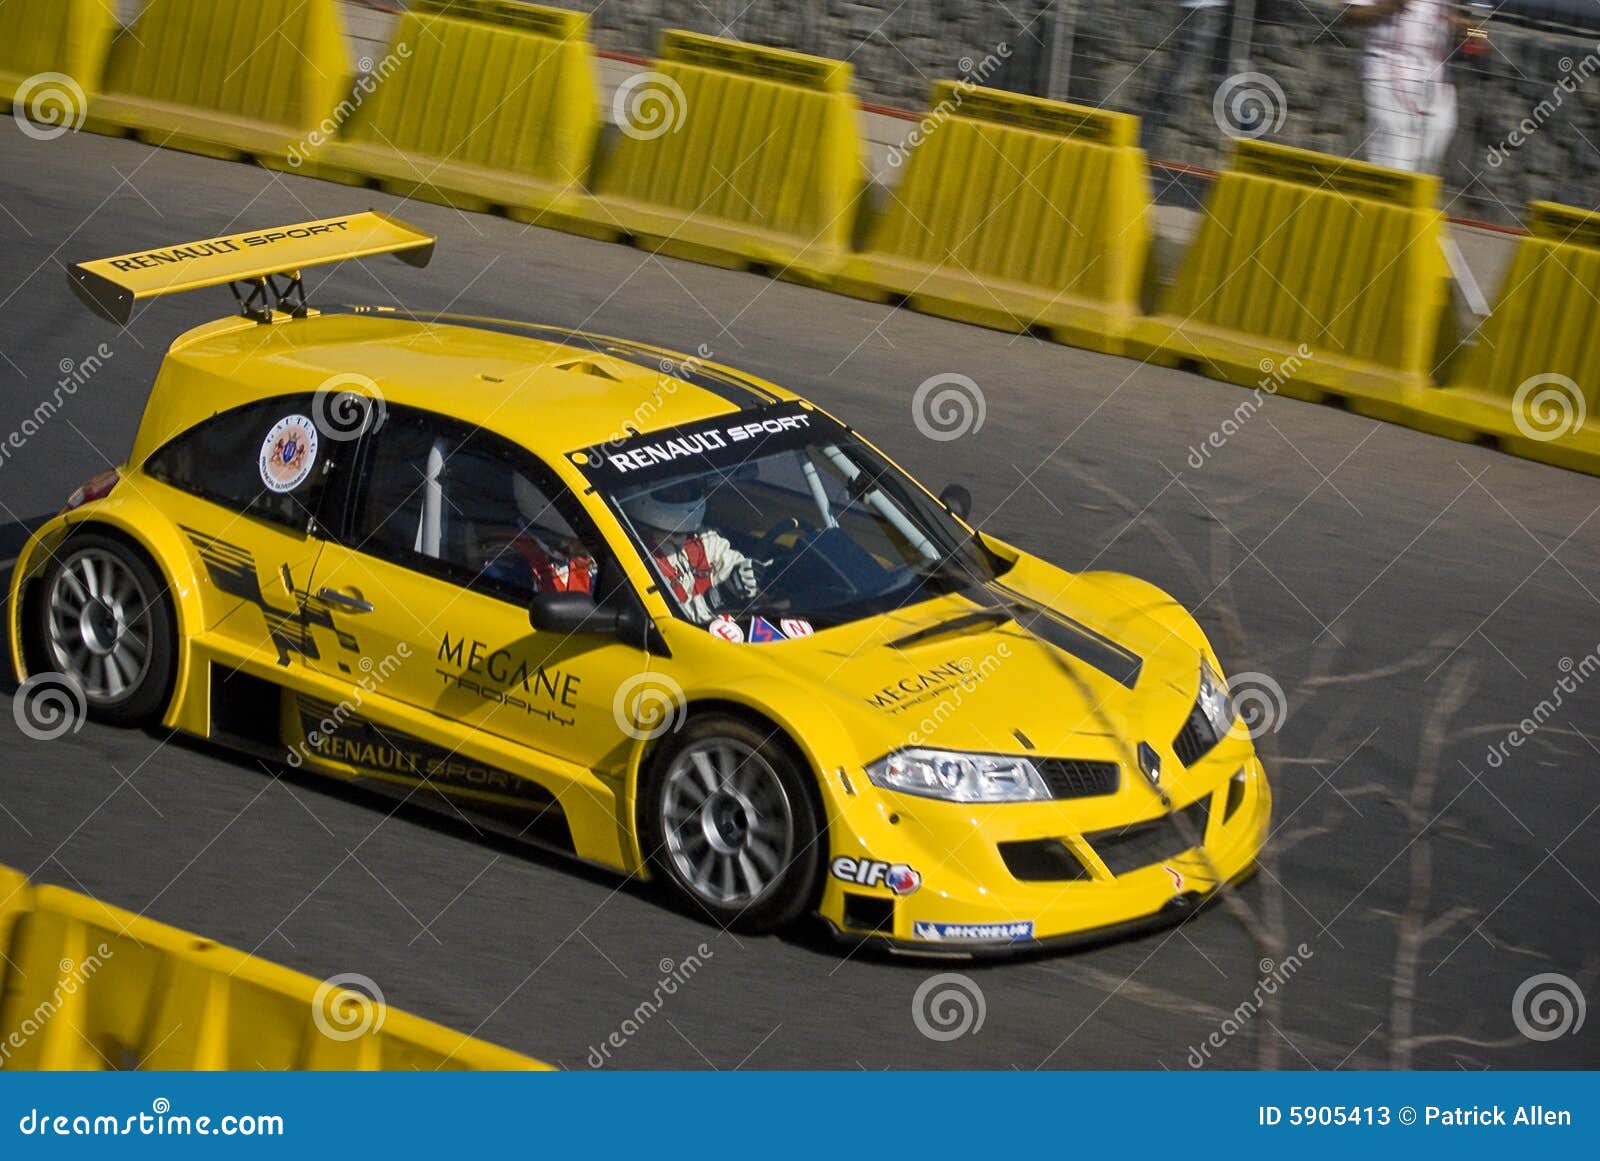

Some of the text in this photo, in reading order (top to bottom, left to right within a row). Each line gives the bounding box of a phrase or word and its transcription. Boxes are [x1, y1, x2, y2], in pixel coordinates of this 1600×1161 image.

[109, 221, 348, 272] RENAULT SPORT
[608, 414, 812, 473] RENAULT SPORT
[435, 668, 576, 727] TROPHY
[437, 631, 581, 709] MEGANE
[316, 733, 523, 790] RENAULT SPORT
[830, 856, 889, 887] elf
[944, 923, 1030, 938] MICHELIN
